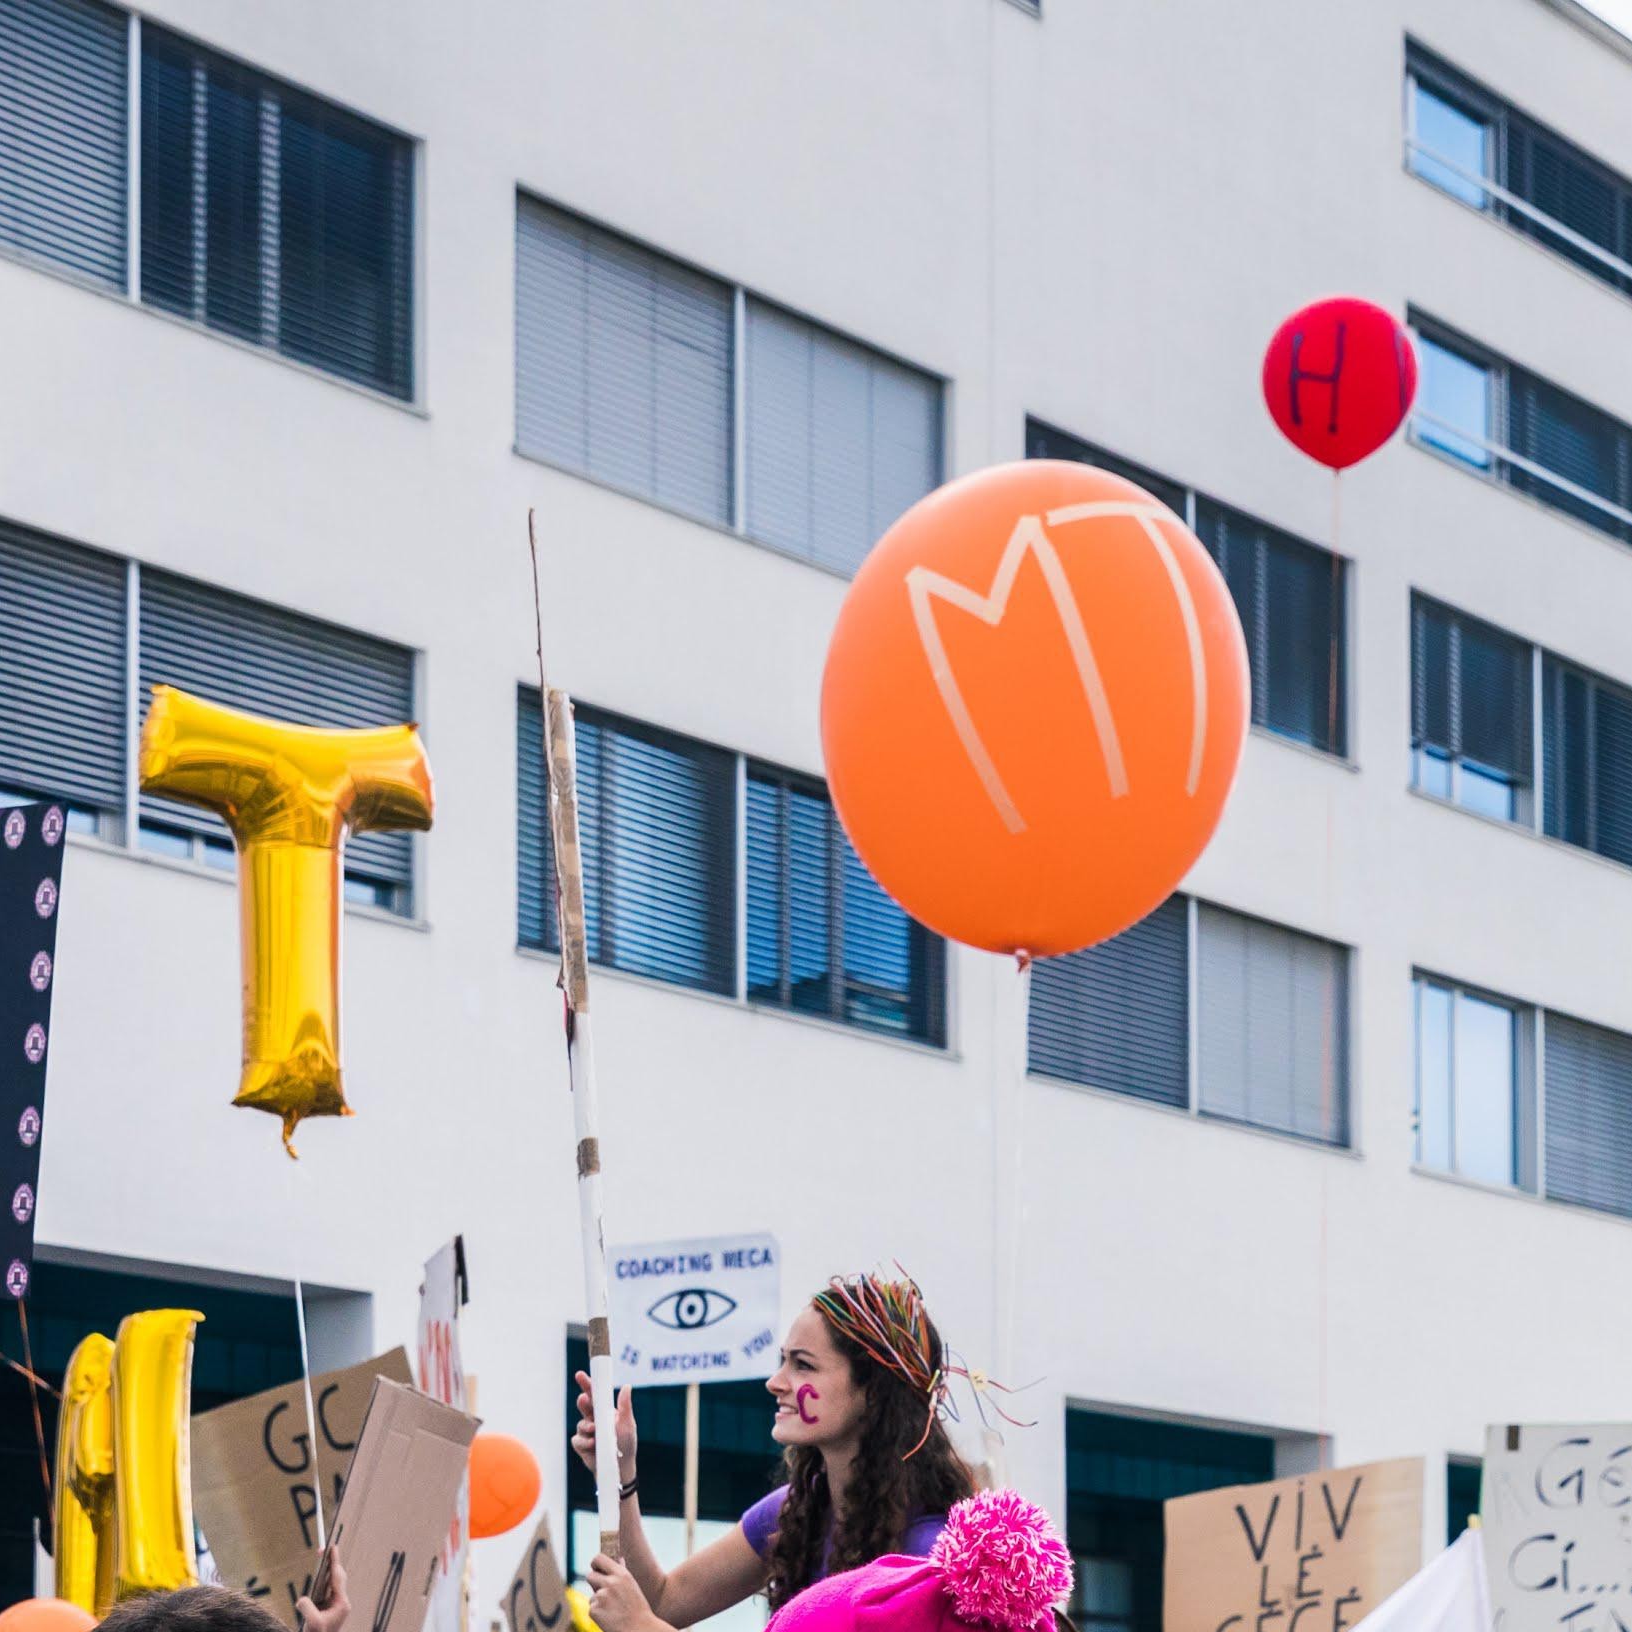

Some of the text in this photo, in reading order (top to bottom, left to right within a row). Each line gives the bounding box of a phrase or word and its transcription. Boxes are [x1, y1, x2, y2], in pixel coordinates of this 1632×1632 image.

[1288, 320, 1348, 434] H
[139, 687, 436, 1120] T
[616, 1252, 713, 1280] COACHING
[651, 1351, 731, 1371] WATCHING
[741, 1329, 774, 1358] YOU
